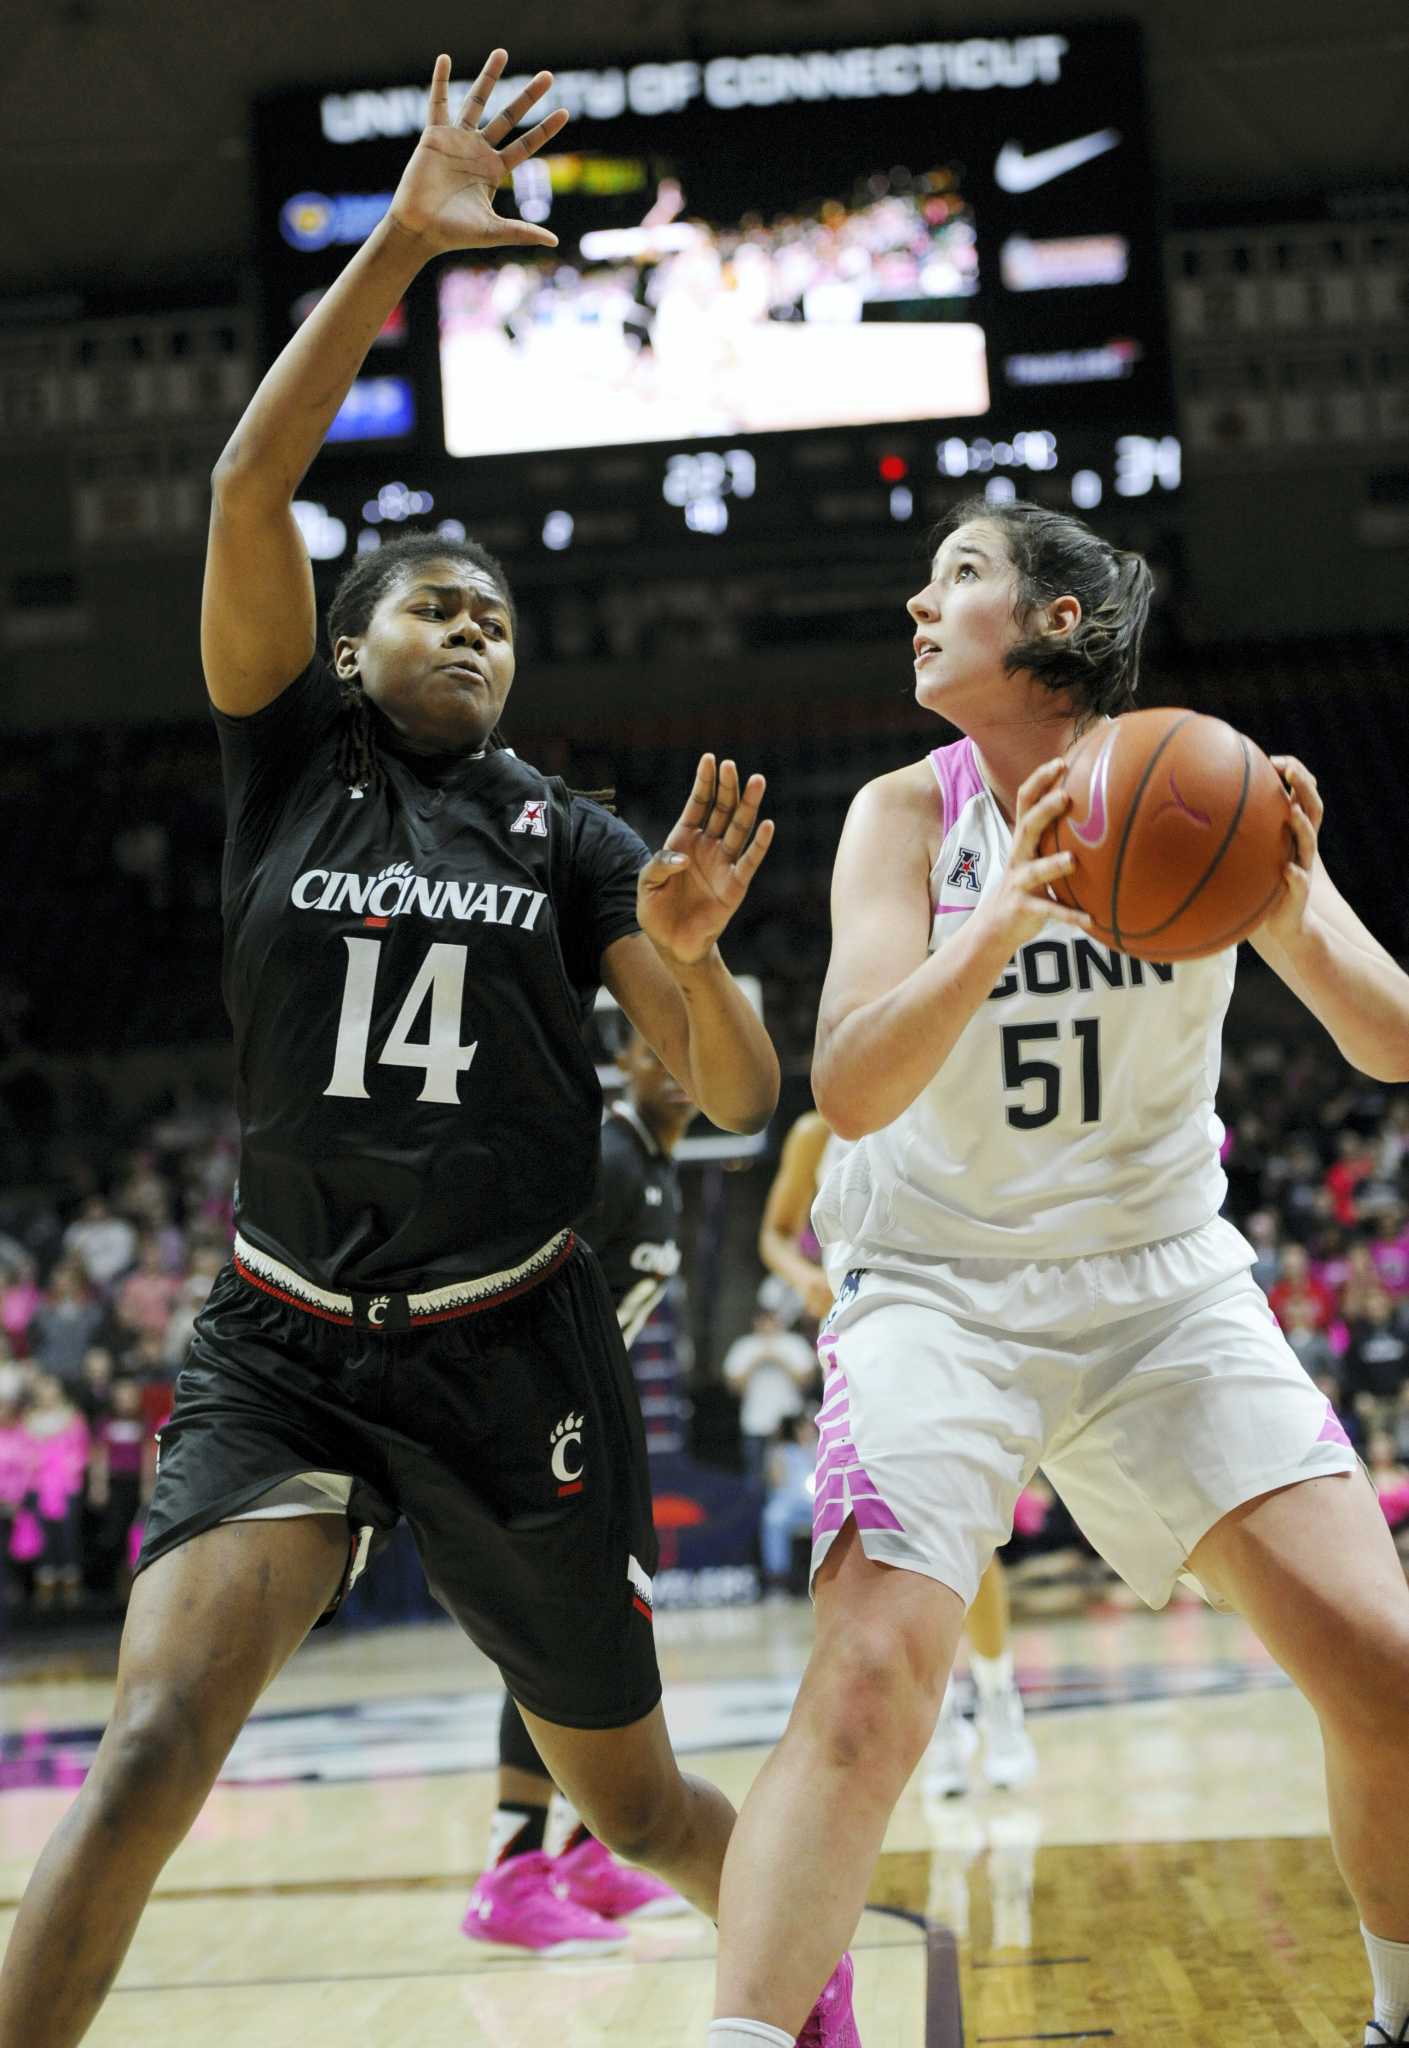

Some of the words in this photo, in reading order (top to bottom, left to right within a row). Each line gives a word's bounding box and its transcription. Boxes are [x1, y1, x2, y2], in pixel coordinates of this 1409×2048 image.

[321, 69, 627, 143] UNIITY
[291, 868, 548, 931] CINCINNATI
[322, 936, 478, 1104] 14
[1000, 1017, 1102, 1130] 51
